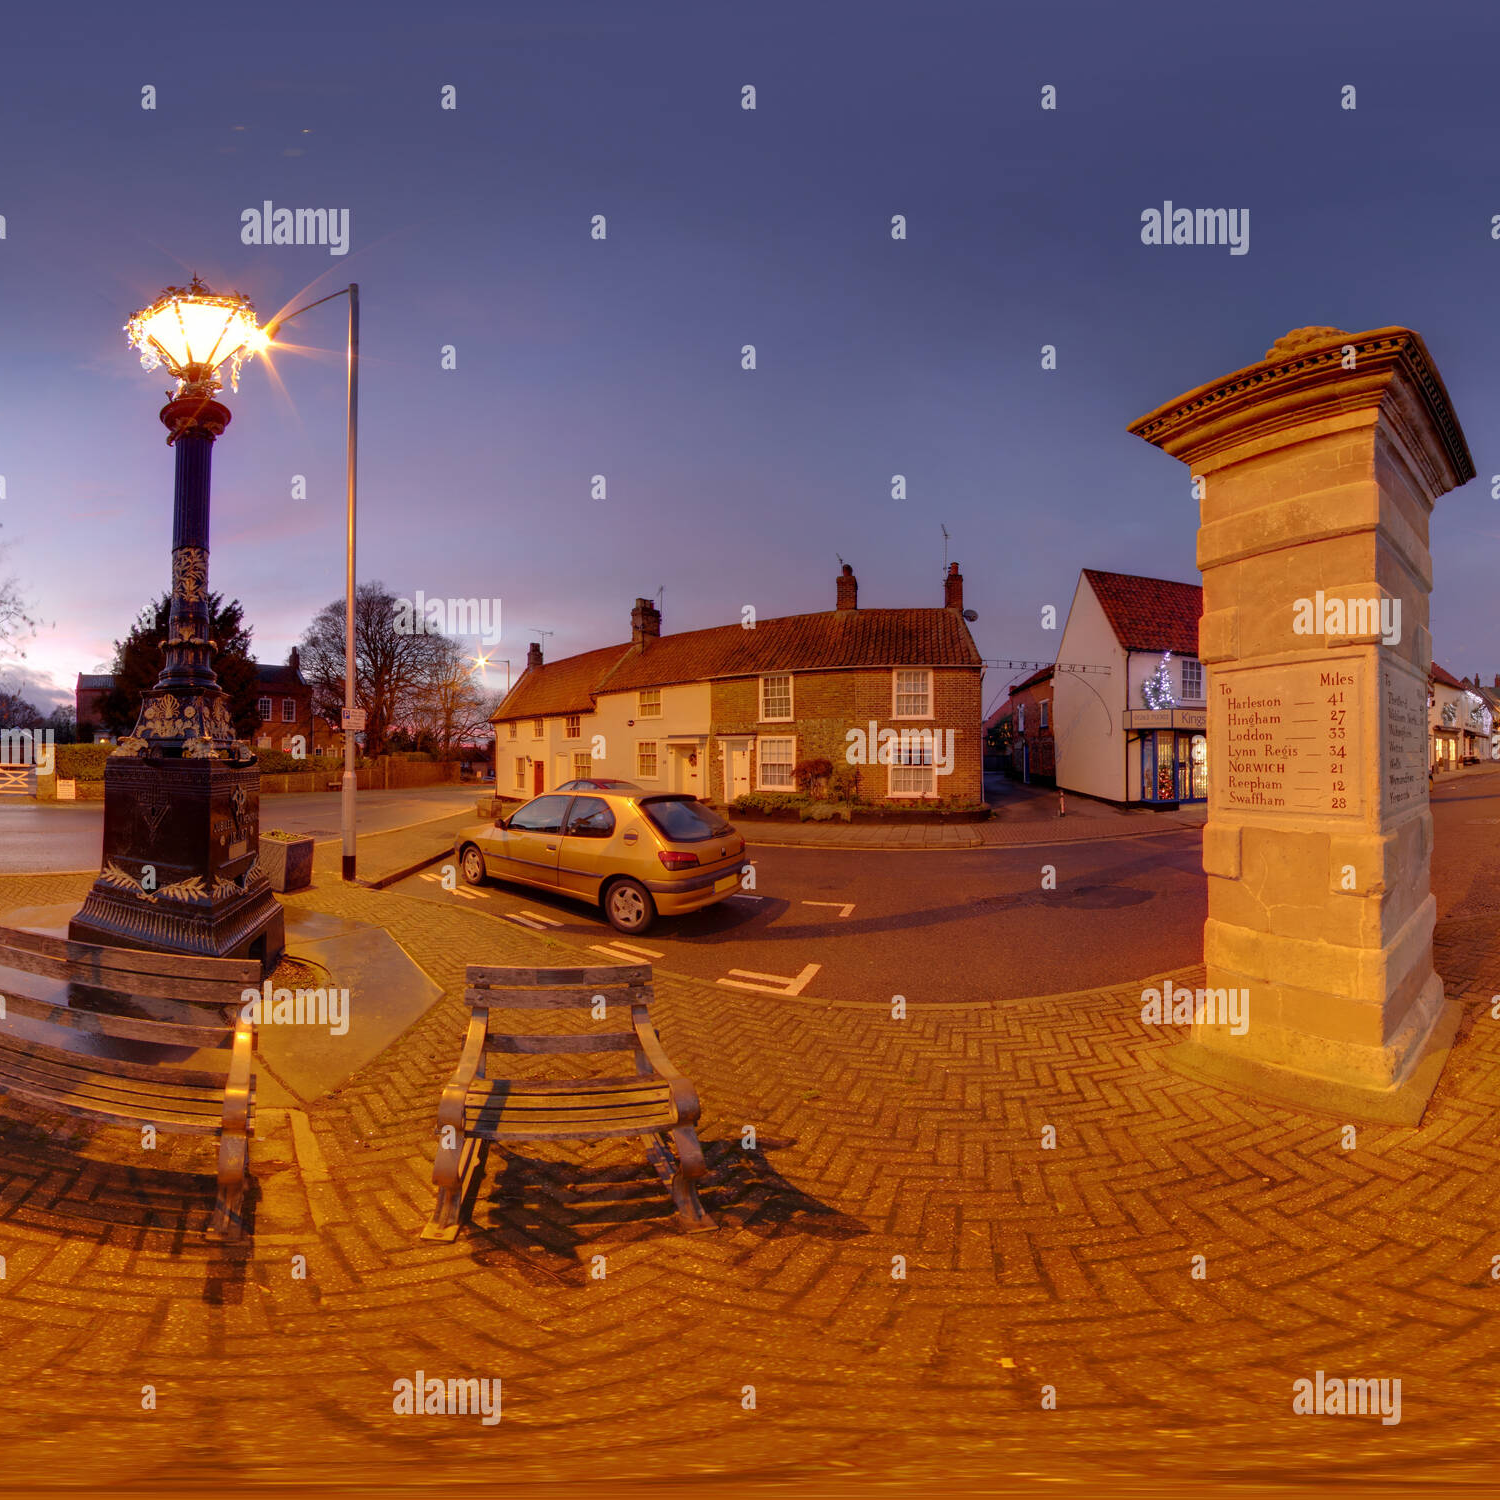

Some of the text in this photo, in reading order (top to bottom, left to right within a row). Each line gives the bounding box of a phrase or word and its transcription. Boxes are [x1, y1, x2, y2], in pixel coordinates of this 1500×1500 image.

[1320, 672, 1354, 686] Miles
[1219, 683, 1232, 695] To
[1228, 692, 1343, 710] Harleston 41
[1228, 710, 1346, 727] Hingham 27
[1228, 727, 1346, 741] Loddon 33
[1228, 744, 1347, 760] Lynn Regis 34
[1228, 760, 1343, 774] NORWICH 21
[1228, 775, 1345, 792] Reepham 12
[1229, 791, 1347, 809] Swaffham 28
